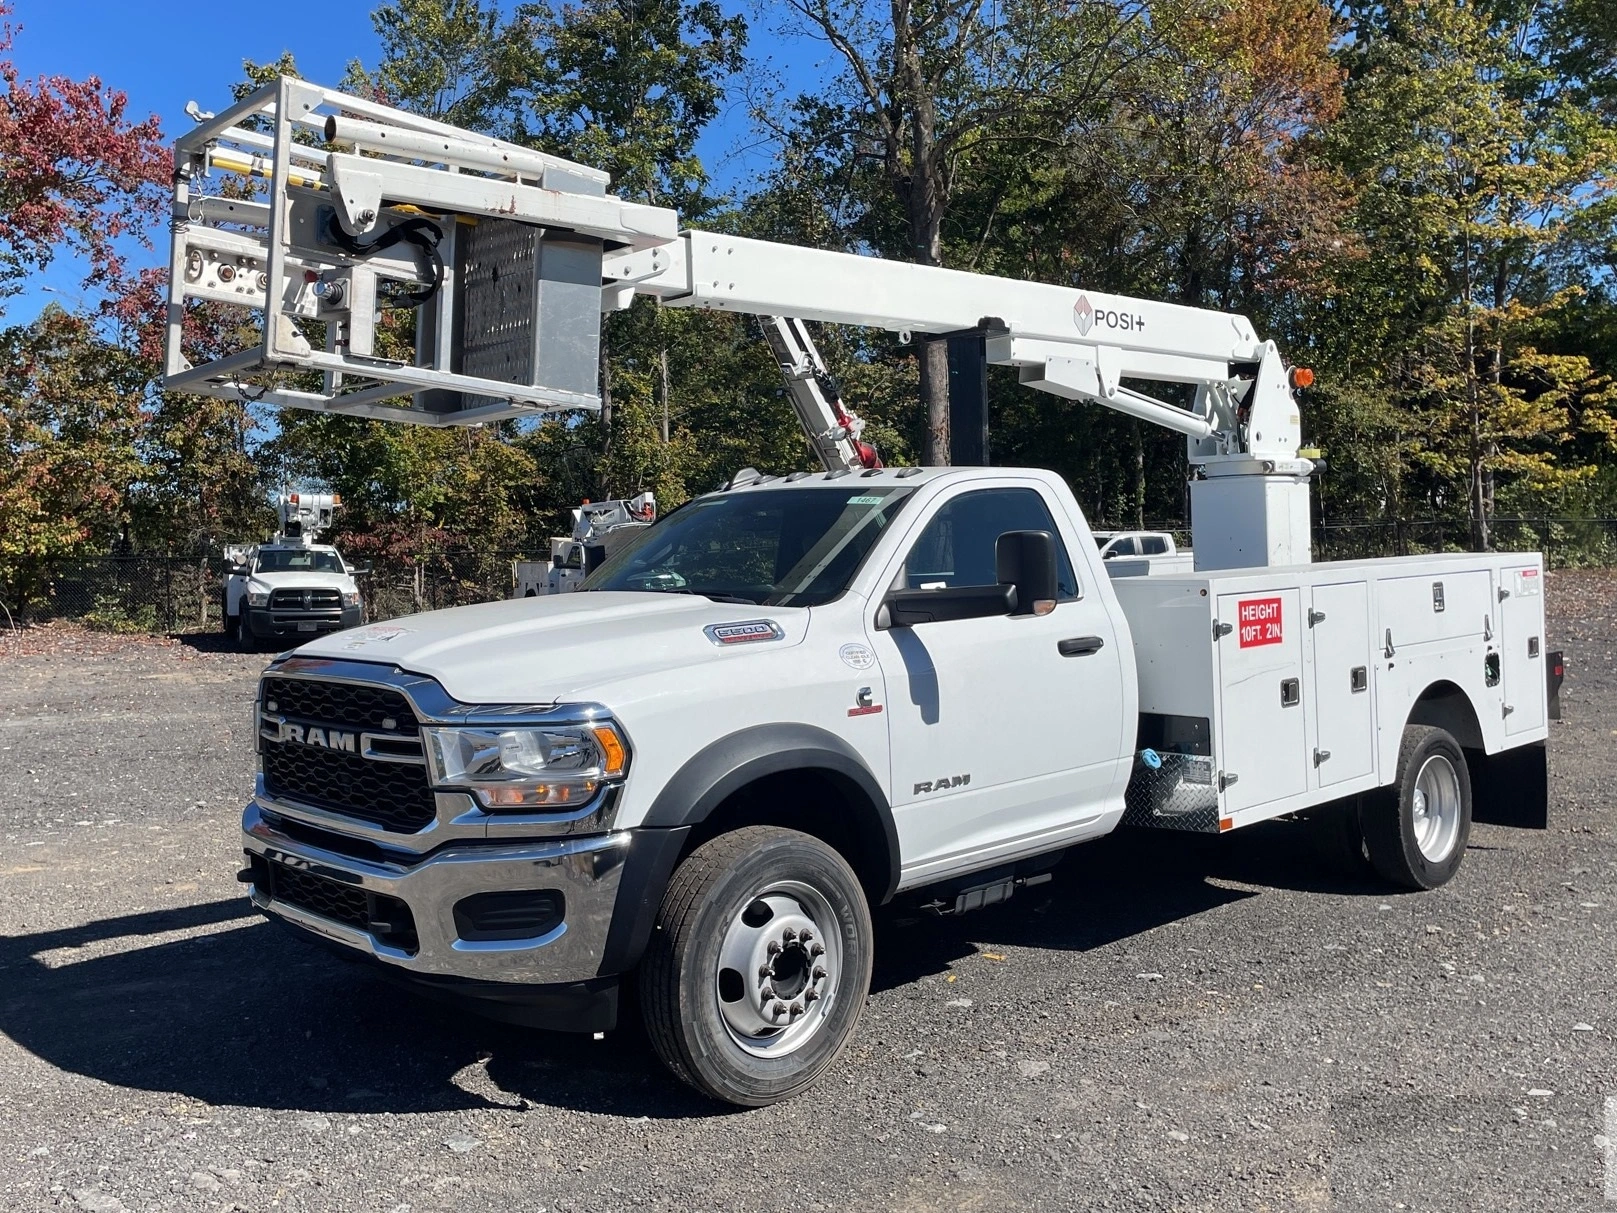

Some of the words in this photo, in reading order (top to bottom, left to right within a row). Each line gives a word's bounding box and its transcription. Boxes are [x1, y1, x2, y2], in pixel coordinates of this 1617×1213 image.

[1241, 603, 1278, 621] HEIGHT
[717, 625, 768, 637] 5500
[1241, 625, 1262, 642] 10FT.
[1266, 622, 1283, 639] 2IN.
[283, 723, 355, 753] RAM
[912, 773, 971, 795] RAM
